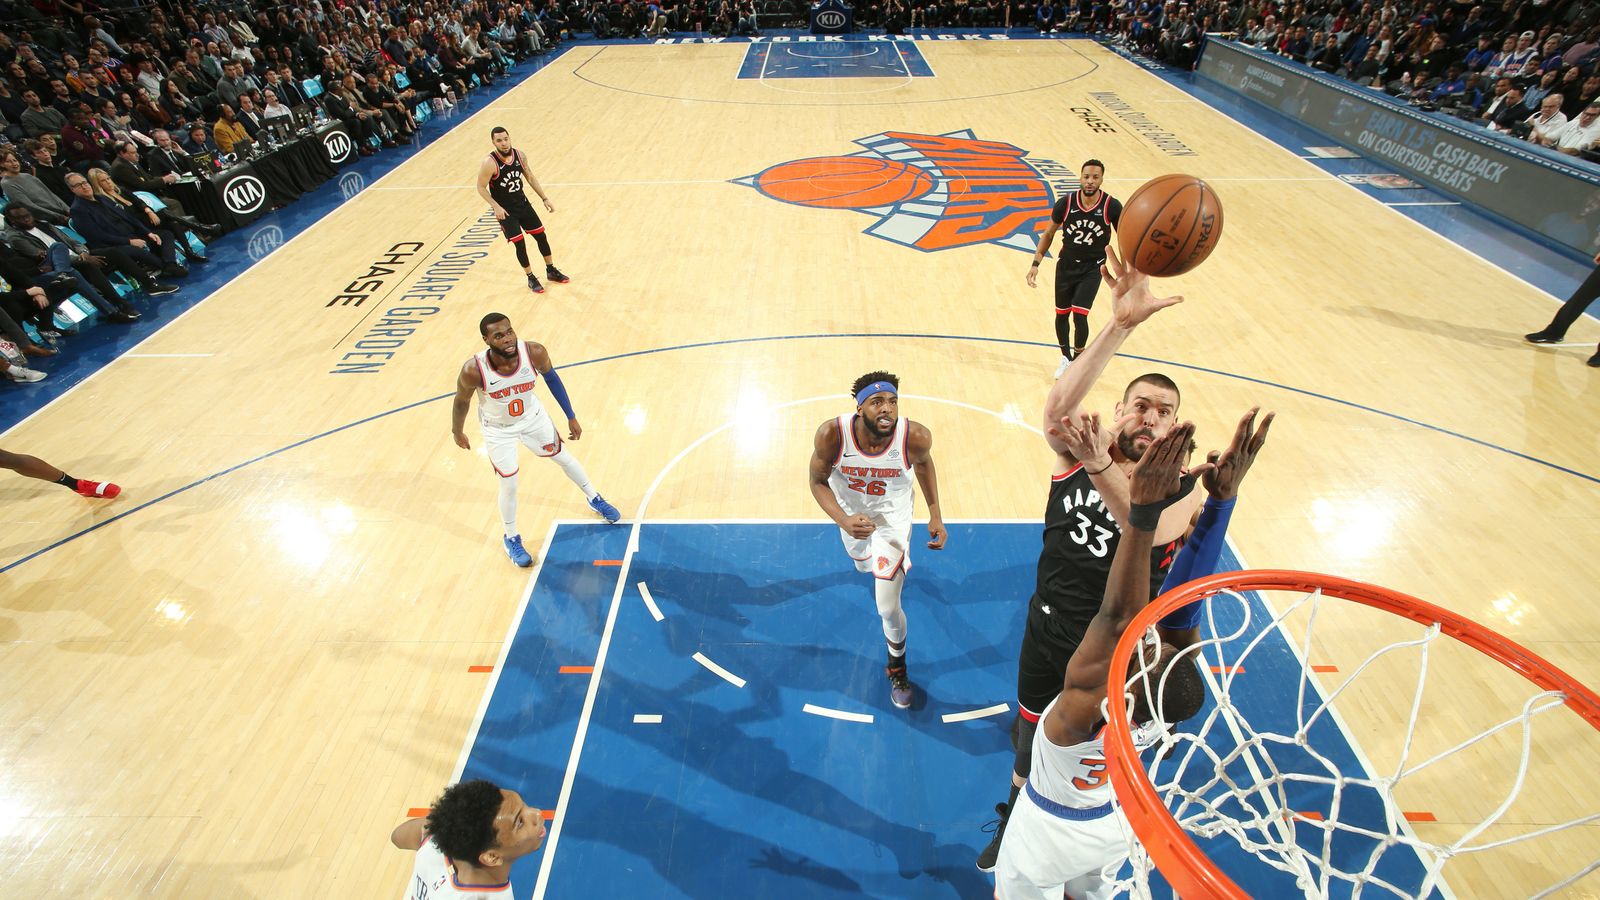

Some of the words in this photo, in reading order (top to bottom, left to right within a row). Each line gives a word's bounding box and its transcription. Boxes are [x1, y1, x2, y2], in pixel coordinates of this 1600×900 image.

[822, 14, 841, 25] KIA
[654, 37, 726, 45] NEW
[1070, 107, 1117, 133] CHASE
[326, 135, 348, 159] KIA
[1364, 111, 1405, 139] EARN
[1432, 141, 1468, 168] CASH
[1468, 152, 1509, 183] BACK
[1357, 130, 1377, 148] ON
[1374, 137, 1436, 176] COURTSIDE
[1432, 165, 1477, 193] SEATS
[227, 181, 262, 209] KIA
[508, 179, 520, 193] 23
[1066, 219, 1104, 237] RAPTORS
[1073, 230, 1094, 245] 24
[325, 241, 425, 308] CHASE
[400, 251, 488, 301] SQUARE
[329, 306, 440, 374] GARDEN
[488, 386, 512, 399] NEW
[513, 380, 536, 394] YORK
[508, 398, 525, 417] 0
[841, 465, 870, 477] NEW
[870, 466, 902, 478] YORK
[848, 477, 887, 496] 26
[1069, 511, 1114, 558] 33
